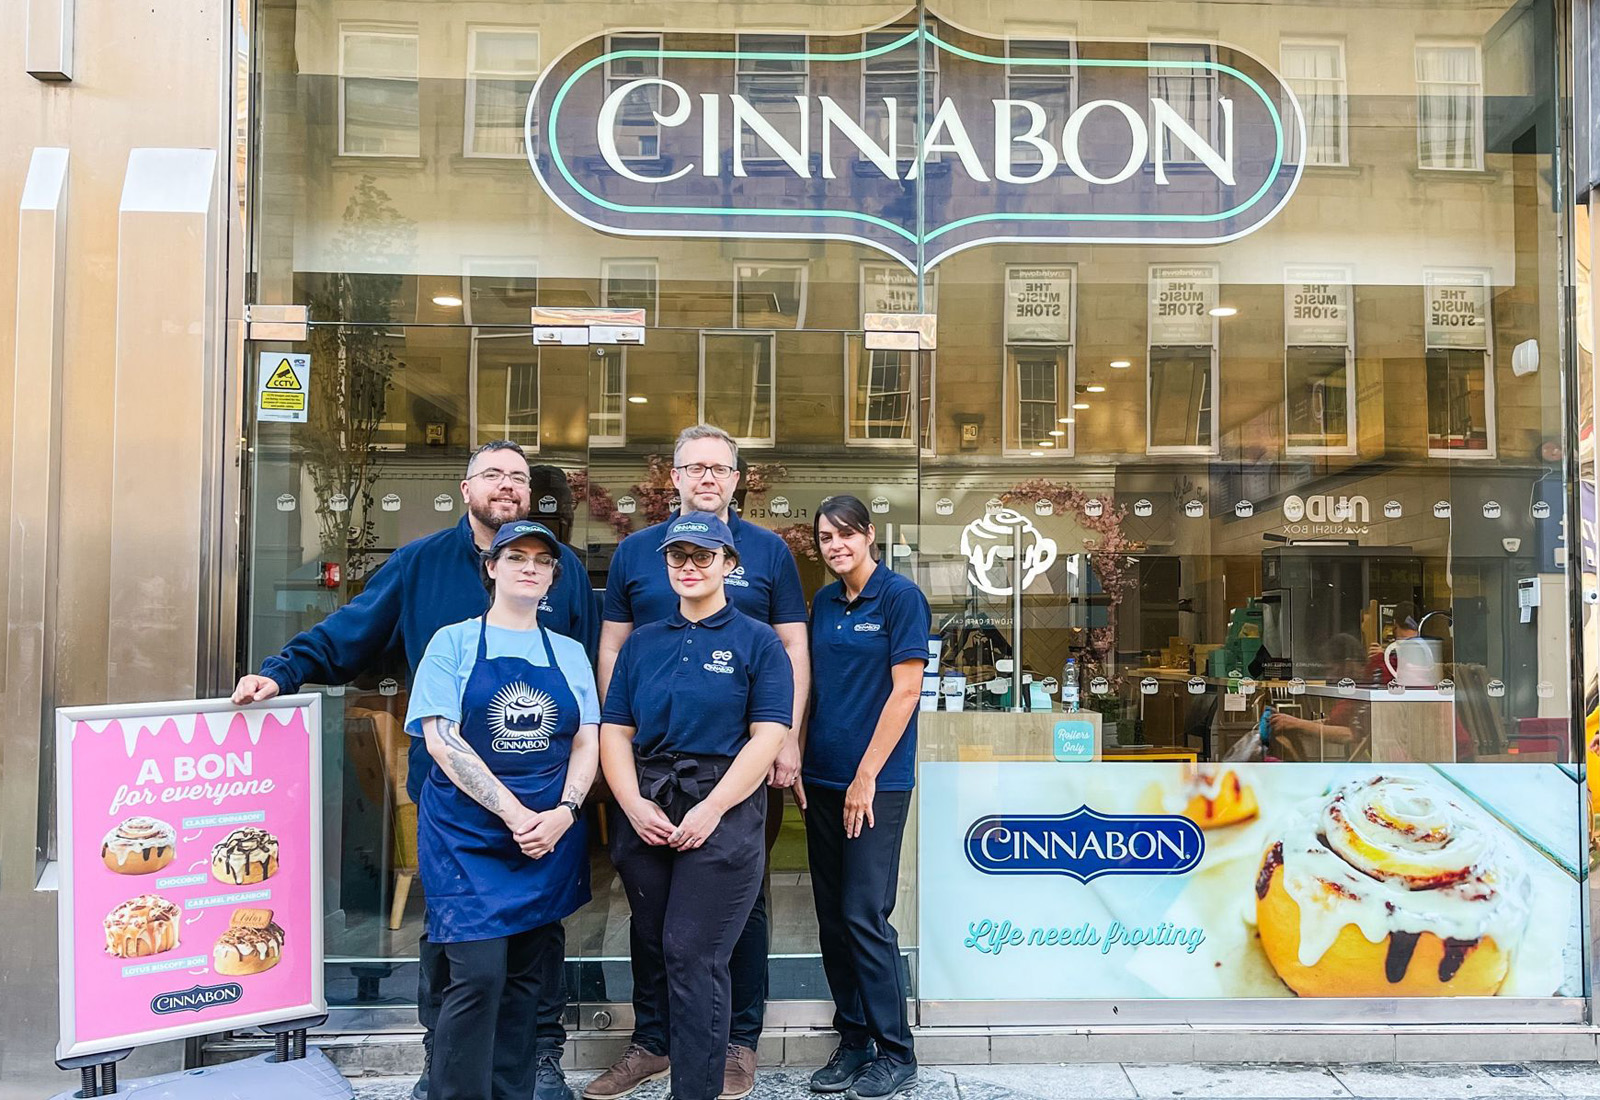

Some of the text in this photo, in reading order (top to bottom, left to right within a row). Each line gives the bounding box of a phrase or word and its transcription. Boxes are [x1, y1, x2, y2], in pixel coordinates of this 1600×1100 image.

[597, 78, 1236, 185] CINNABON
[495, 740, 548, 750] CINNABON
[1062, 741, 1086, 755] Only
[135, 751, 253, 786] A BON
[109, 778, 276, 816] for everyone
[185, 817, 217, 825] CLASSIC
[981, 827, 1187, 862] CINNABON
[159, 875, 205, 886] CHOCOBON
[187, 891, 269, 907] CARAMEL PECANBON
[964, 918, 1206, 955] Life needs frosting
[124, 966, 151, 976] LOTUS
[186, 957, 206, 967] BON
[156, 987, 237, 1011] CINNABON
